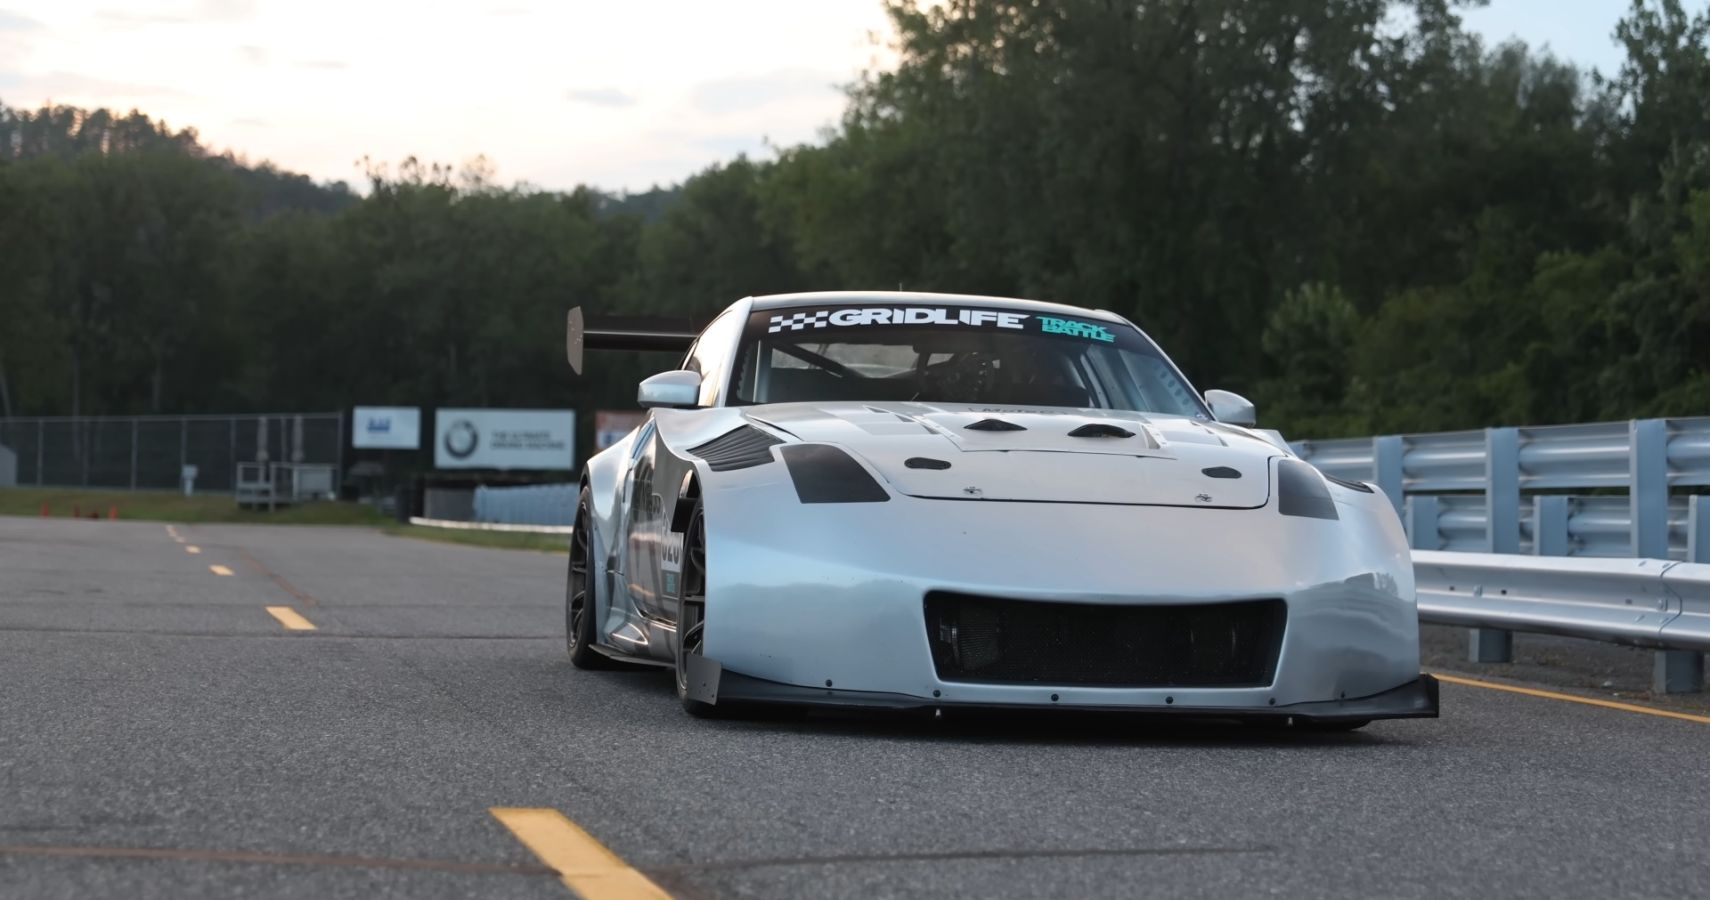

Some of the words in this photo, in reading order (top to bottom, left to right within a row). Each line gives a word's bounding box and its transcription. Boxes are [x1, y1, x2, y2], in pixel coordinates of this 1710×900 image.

[829, 307, 1029, 329] GRIDLIFE
[1036, 316, 1107, 332] TRACK
[1041, 324, 1116, 343] BATTLE
